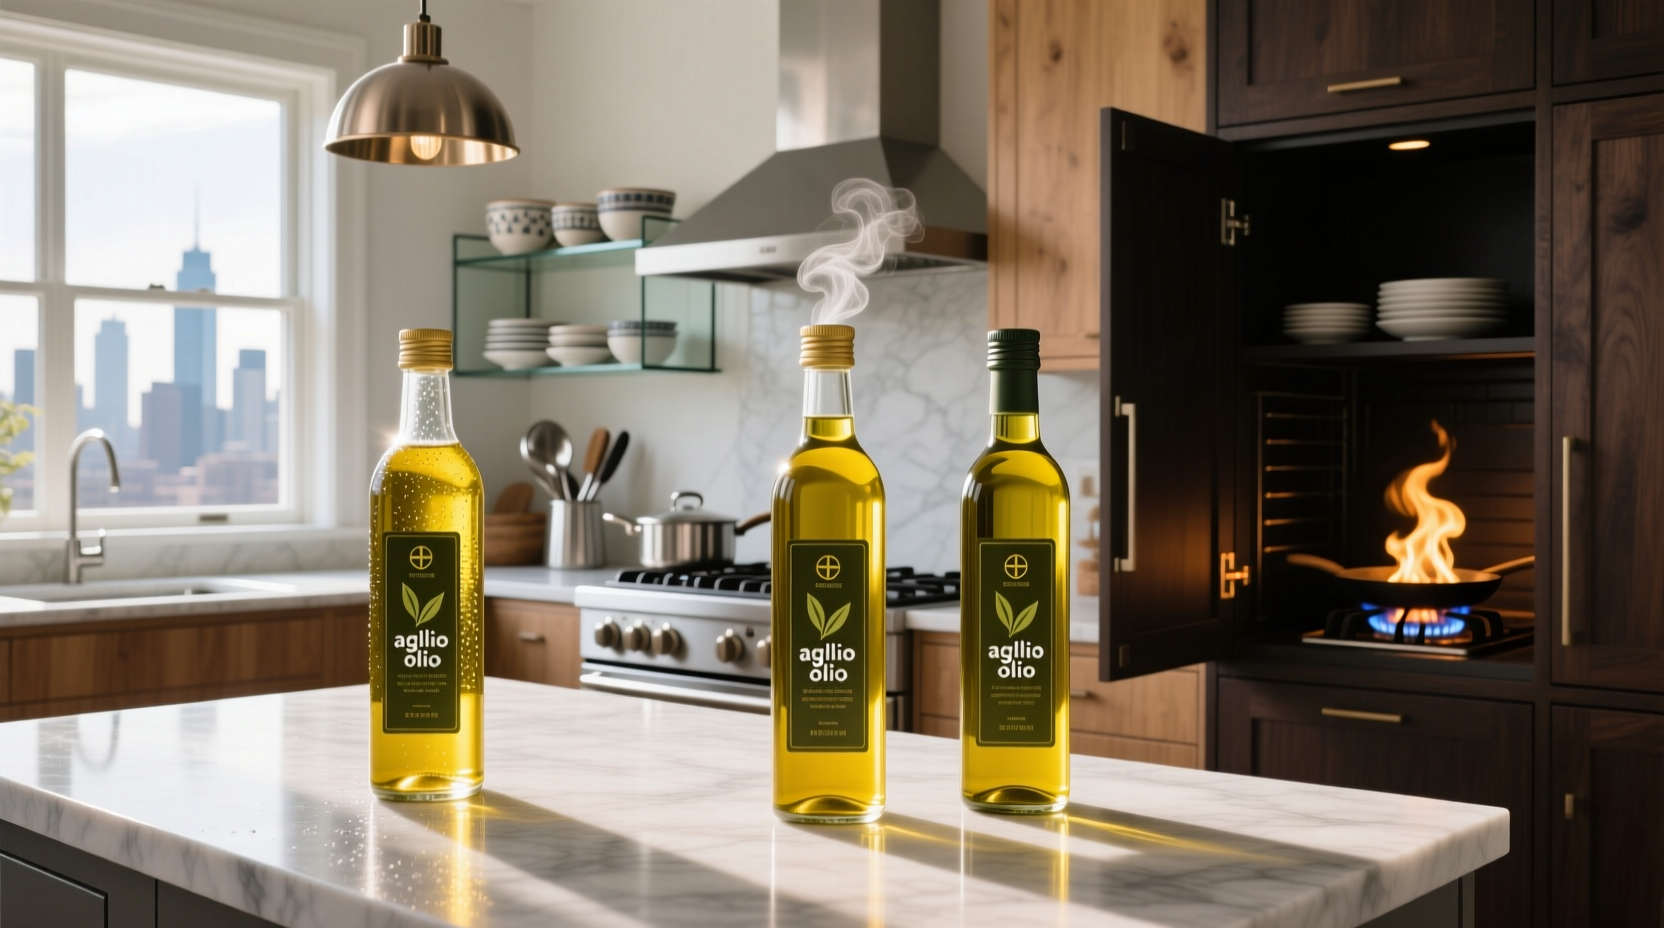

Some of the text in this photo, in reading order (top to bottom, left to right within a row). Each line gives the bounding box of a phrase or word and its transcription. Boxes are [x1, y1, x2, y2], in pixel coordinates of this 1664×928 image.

[394, 629, 449, 653] agllio
[404, 650, 442, 668] olio
[799, 642, 856, 667] agllio
[988, 640, 1044, 664] agllio
[809, 663, 848, 682] olio
[997, 660, 1036, 678] olio
